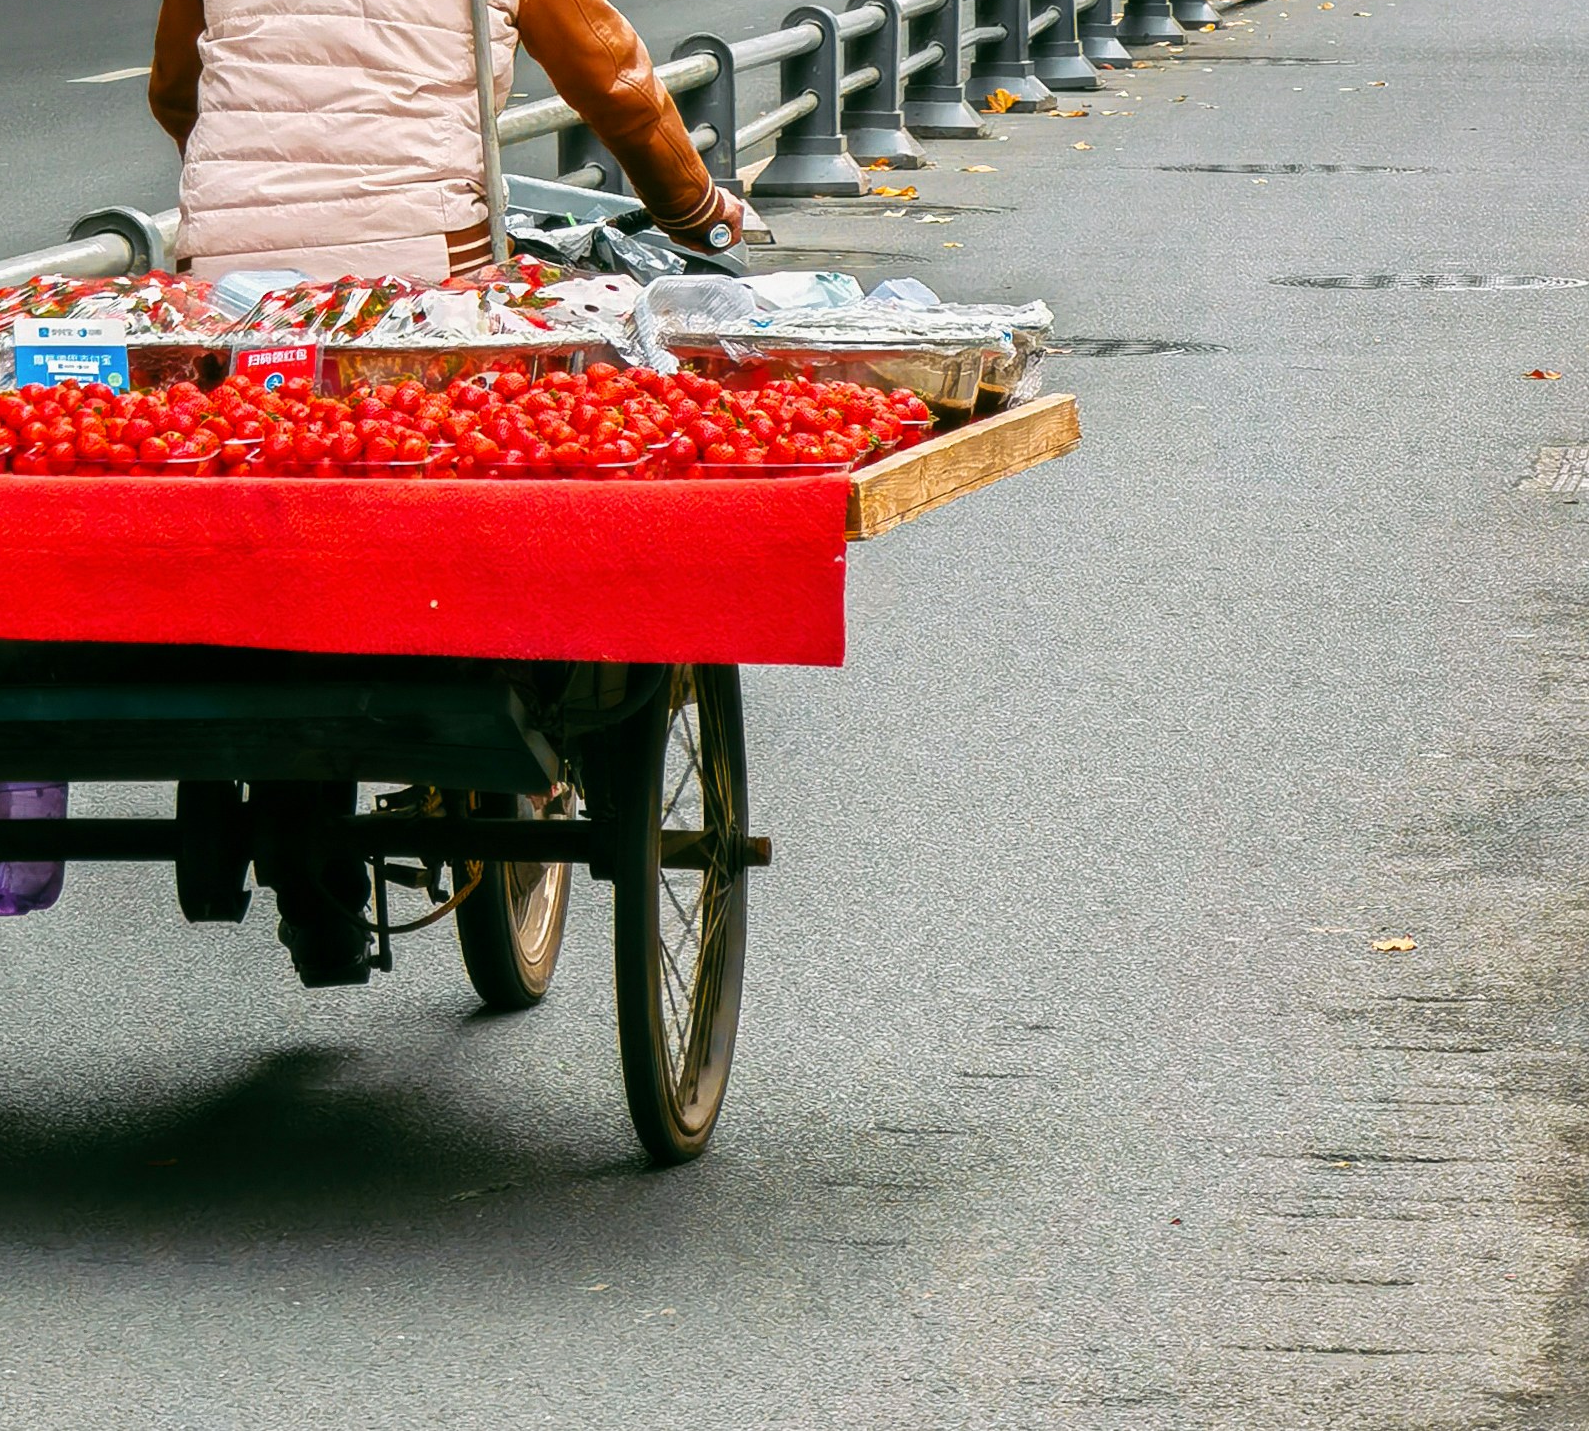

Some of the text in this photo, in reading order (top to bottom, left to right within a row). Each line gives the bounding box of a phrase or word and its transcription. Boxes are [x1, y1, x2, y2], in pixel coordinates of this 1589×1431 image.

[248, 348, 308, 367] 扫码领红包
